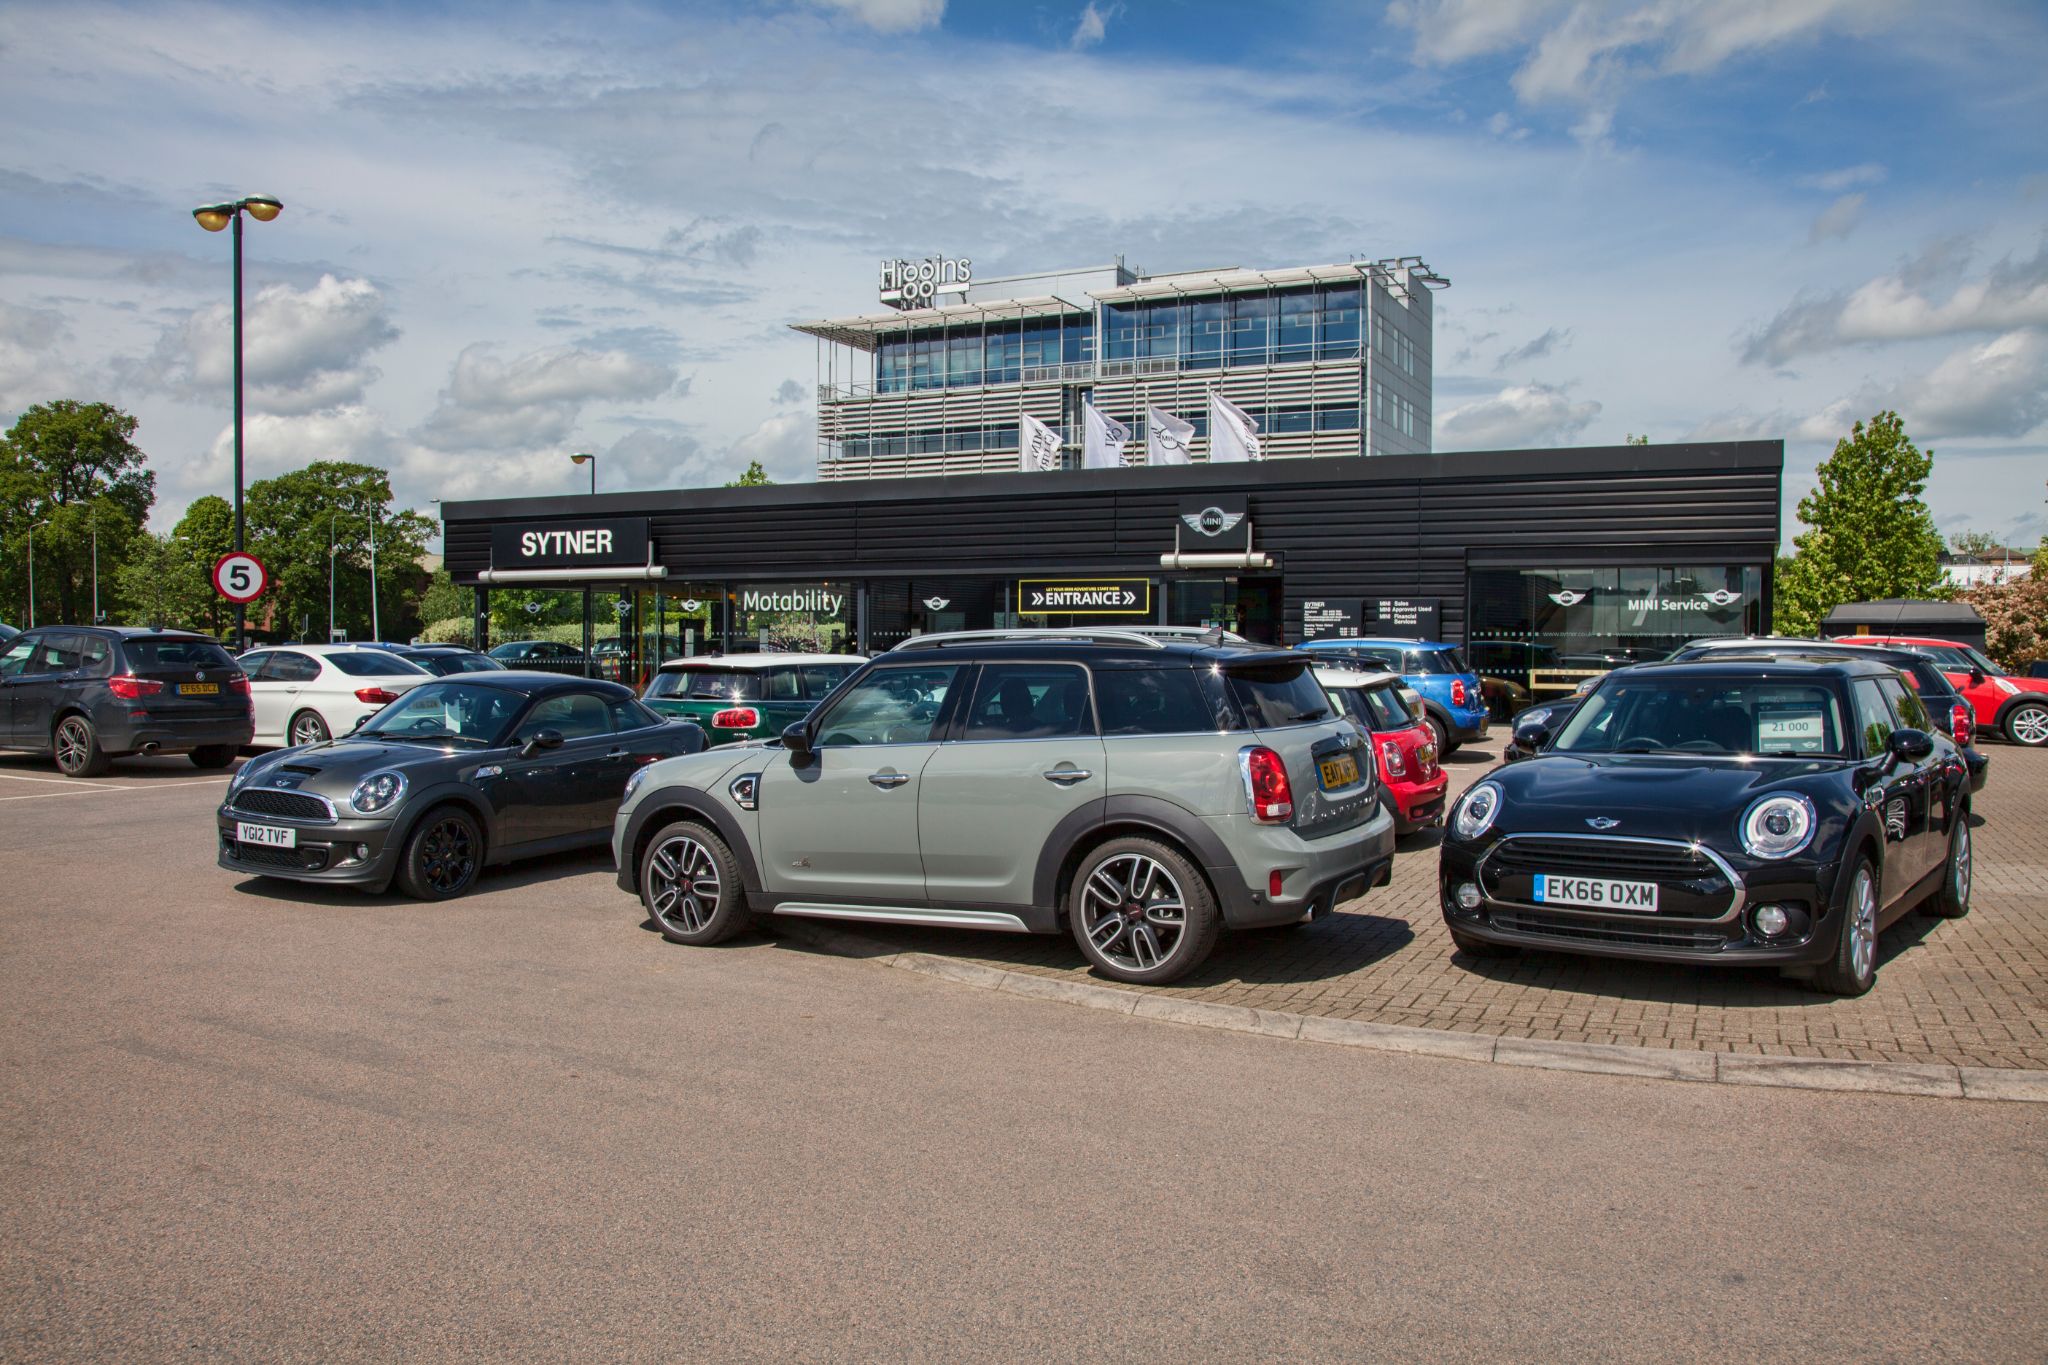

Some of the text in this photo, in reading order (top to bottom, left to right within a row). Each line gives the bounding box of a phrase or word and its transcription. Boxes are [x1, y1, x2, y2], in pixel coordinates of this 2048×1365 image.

[880, 254, 972, 299] Higgins
[1202, 517, 1221, 526] MINI
[521, 529, 613, 557] SYTNER
[230, 565, 251, 591] 5
[743, 588, 843, 617] Motability
[1045, 592, 1121, 605] ENTRANCE
[1628, 598, 1709, 611] MINI Service
[1771, 722, 1809, 732] 21 000
[243, 825, 288, 844] YG12 TVF
[1548, 878, 1654, 906] EK66 OXM
